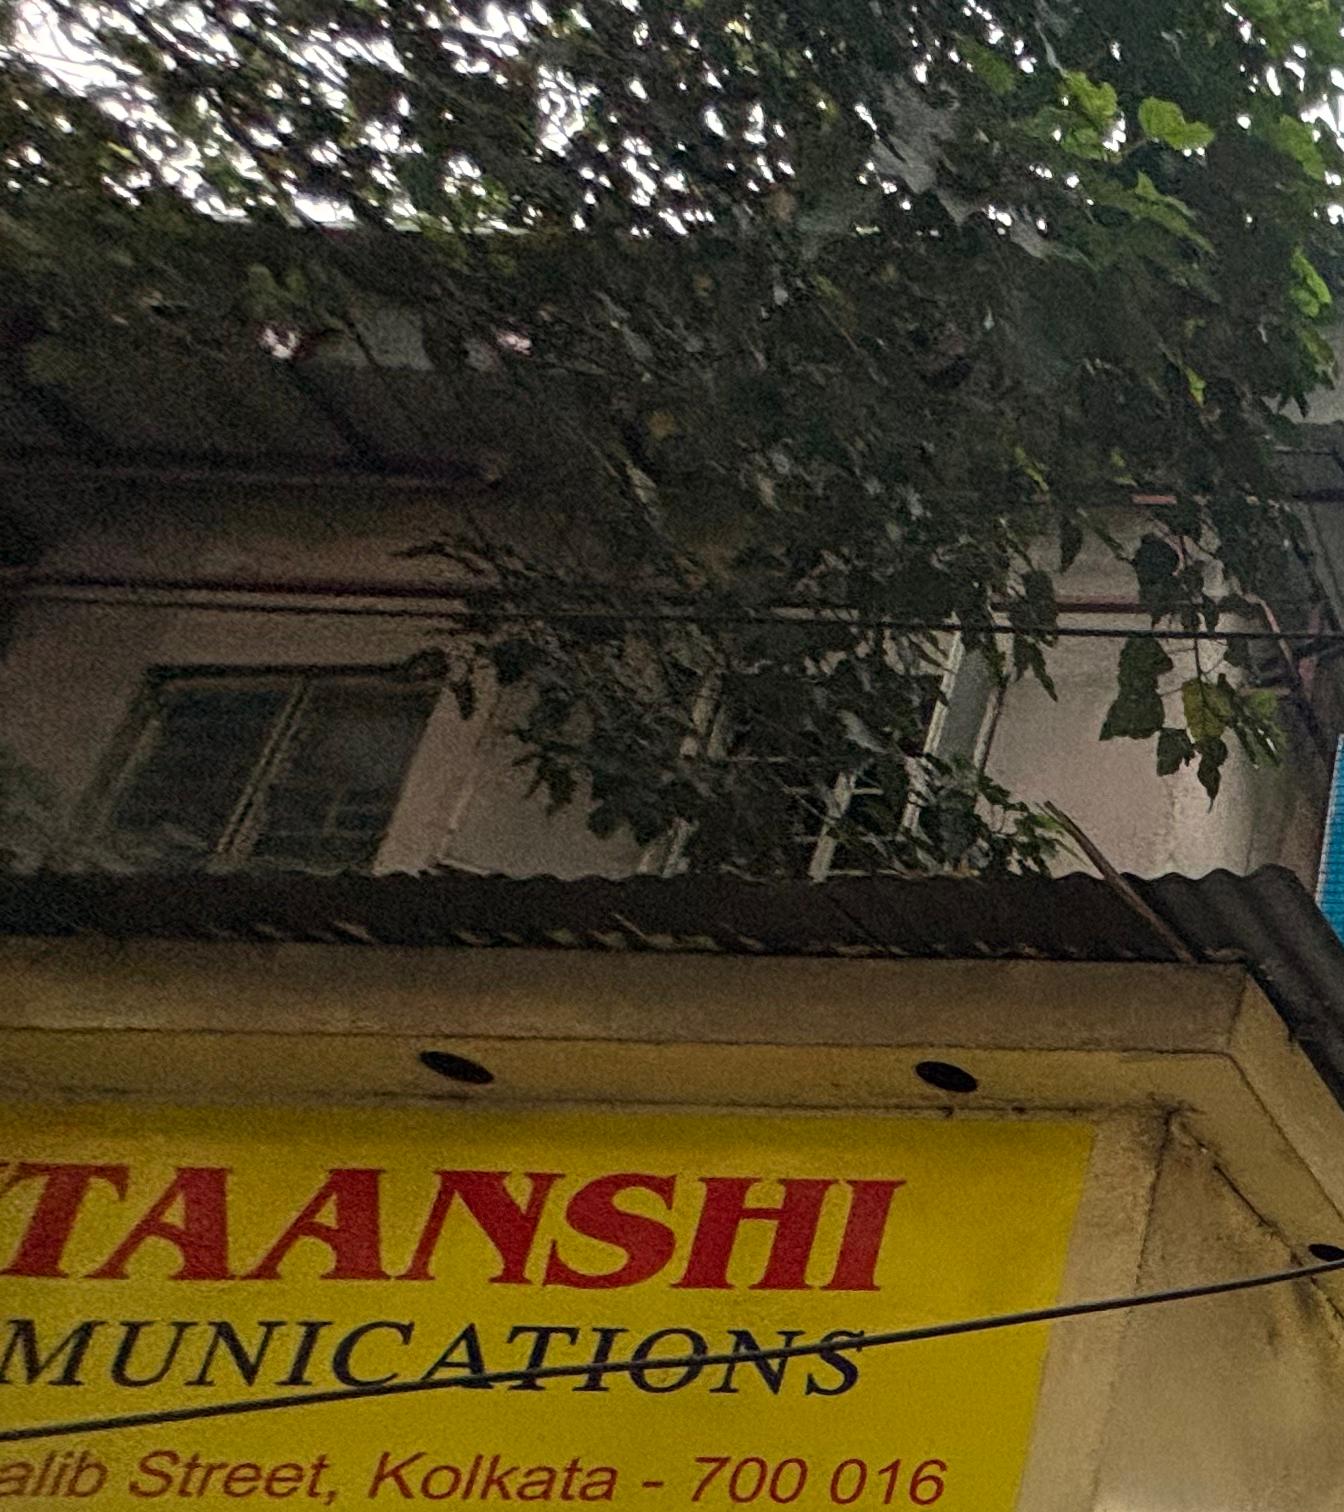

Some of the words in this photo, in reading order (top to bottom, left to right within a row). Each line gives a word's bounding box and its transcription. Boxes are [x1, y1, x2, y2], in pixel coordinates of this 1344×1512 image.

[0, 1162, 907, 1291] TAANSHI
[128, 1449, 339, 1506] Street,
[367, 1451, 620, 1501] Kolkata
[690, 1455, 809, 1505] 700
[830, 1457, 949, 1507] 016
